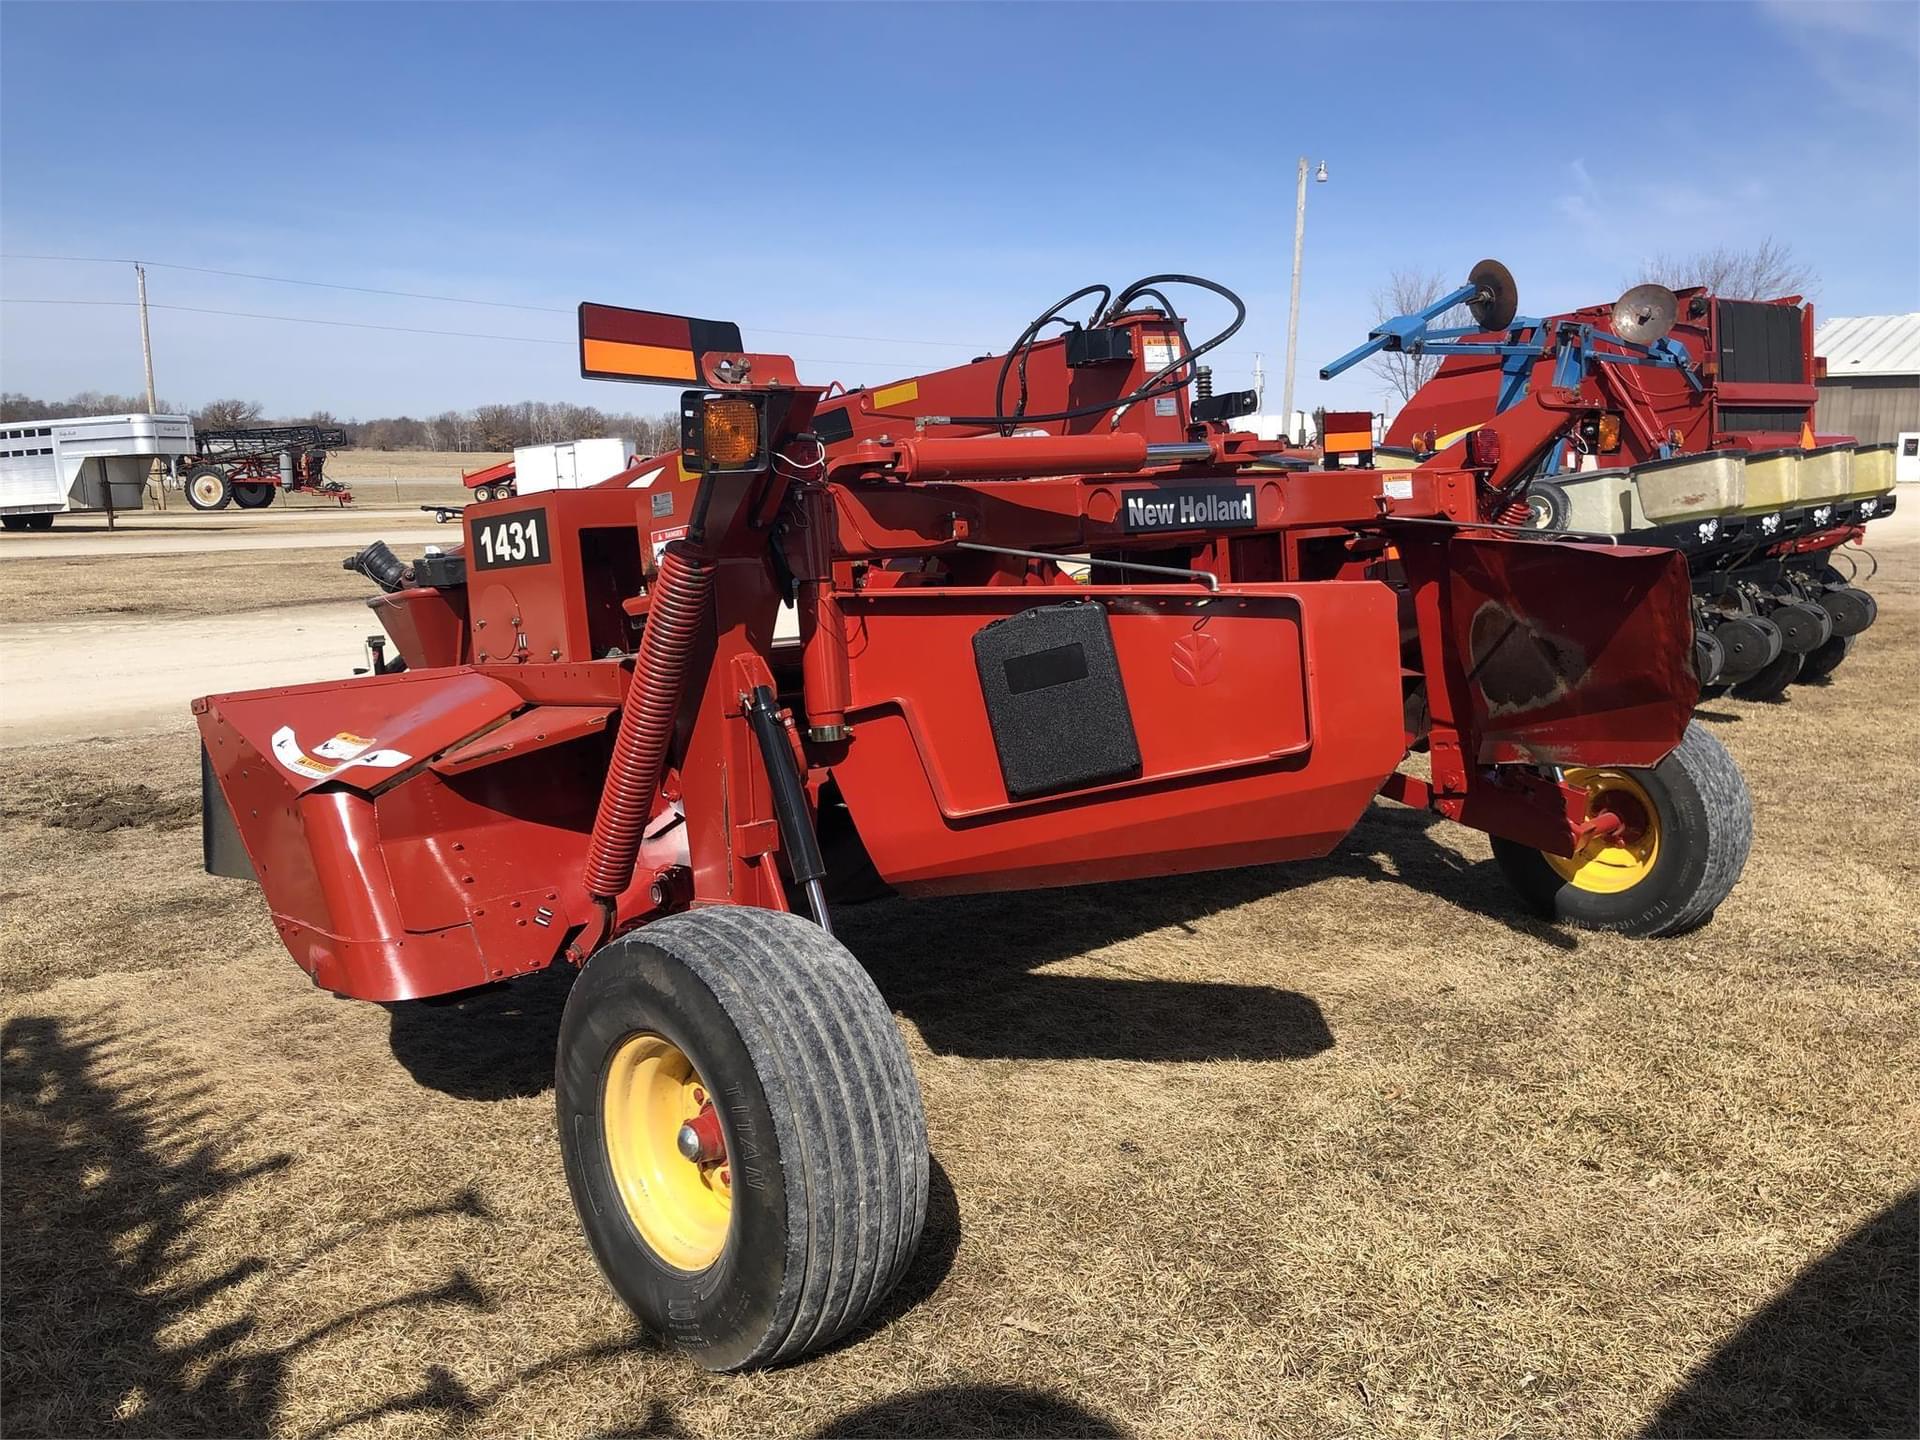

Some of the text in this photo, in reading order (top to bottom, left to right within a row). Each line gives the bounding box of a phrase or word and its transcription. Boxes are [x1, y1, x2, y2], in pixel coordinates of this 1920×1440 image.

[1127, 492, 1252, 527] New Holland
[480, 519, 540, 563] 1431
[725, 1081, 766, 1191] TITAN
